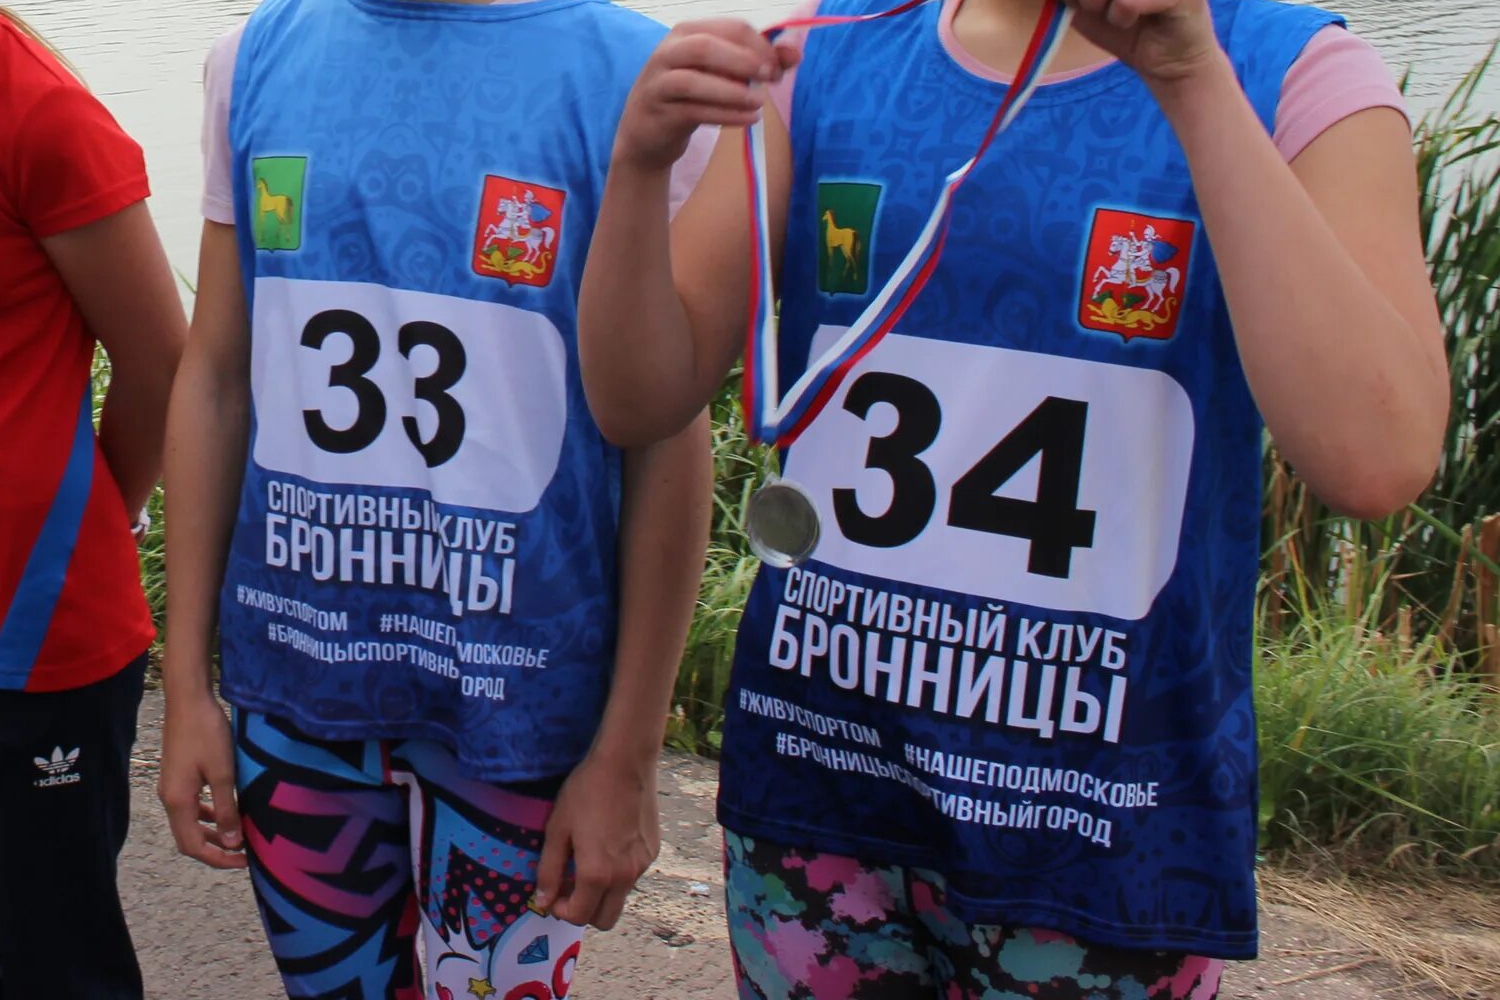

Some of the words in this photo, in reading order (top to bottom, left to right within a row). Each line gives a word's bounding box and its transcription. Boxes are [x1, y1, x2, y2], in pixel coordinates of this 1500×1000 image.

[300, 309, 467, 468] 33
[832, 371, 1097, 579] 34
[438, 513, 516, 554] КЛУБ
[237, 584, 348, 632] #ЖИВУСПОРТОМ
[380, 613, 550, 669] #НАШЕПМОСКОВЬЕ
[268, 622, 505, 700] #БРОННИЦЫСПОРТИВНЫОРОД
[784, 566, 1007, 652] СПОРТИВНЫЙ
[1017, 617, 1127, 670] КЛУБ
[769, 603, 1127, 743] БРОННИЦЫ
[33, 773, 81, 787] adidas
[740, 687, 882, 748] #ЖИВУСПОРТОМ
[905, 743, 1159, 808] #НАШЕПОДМОСКОВЬЕ
